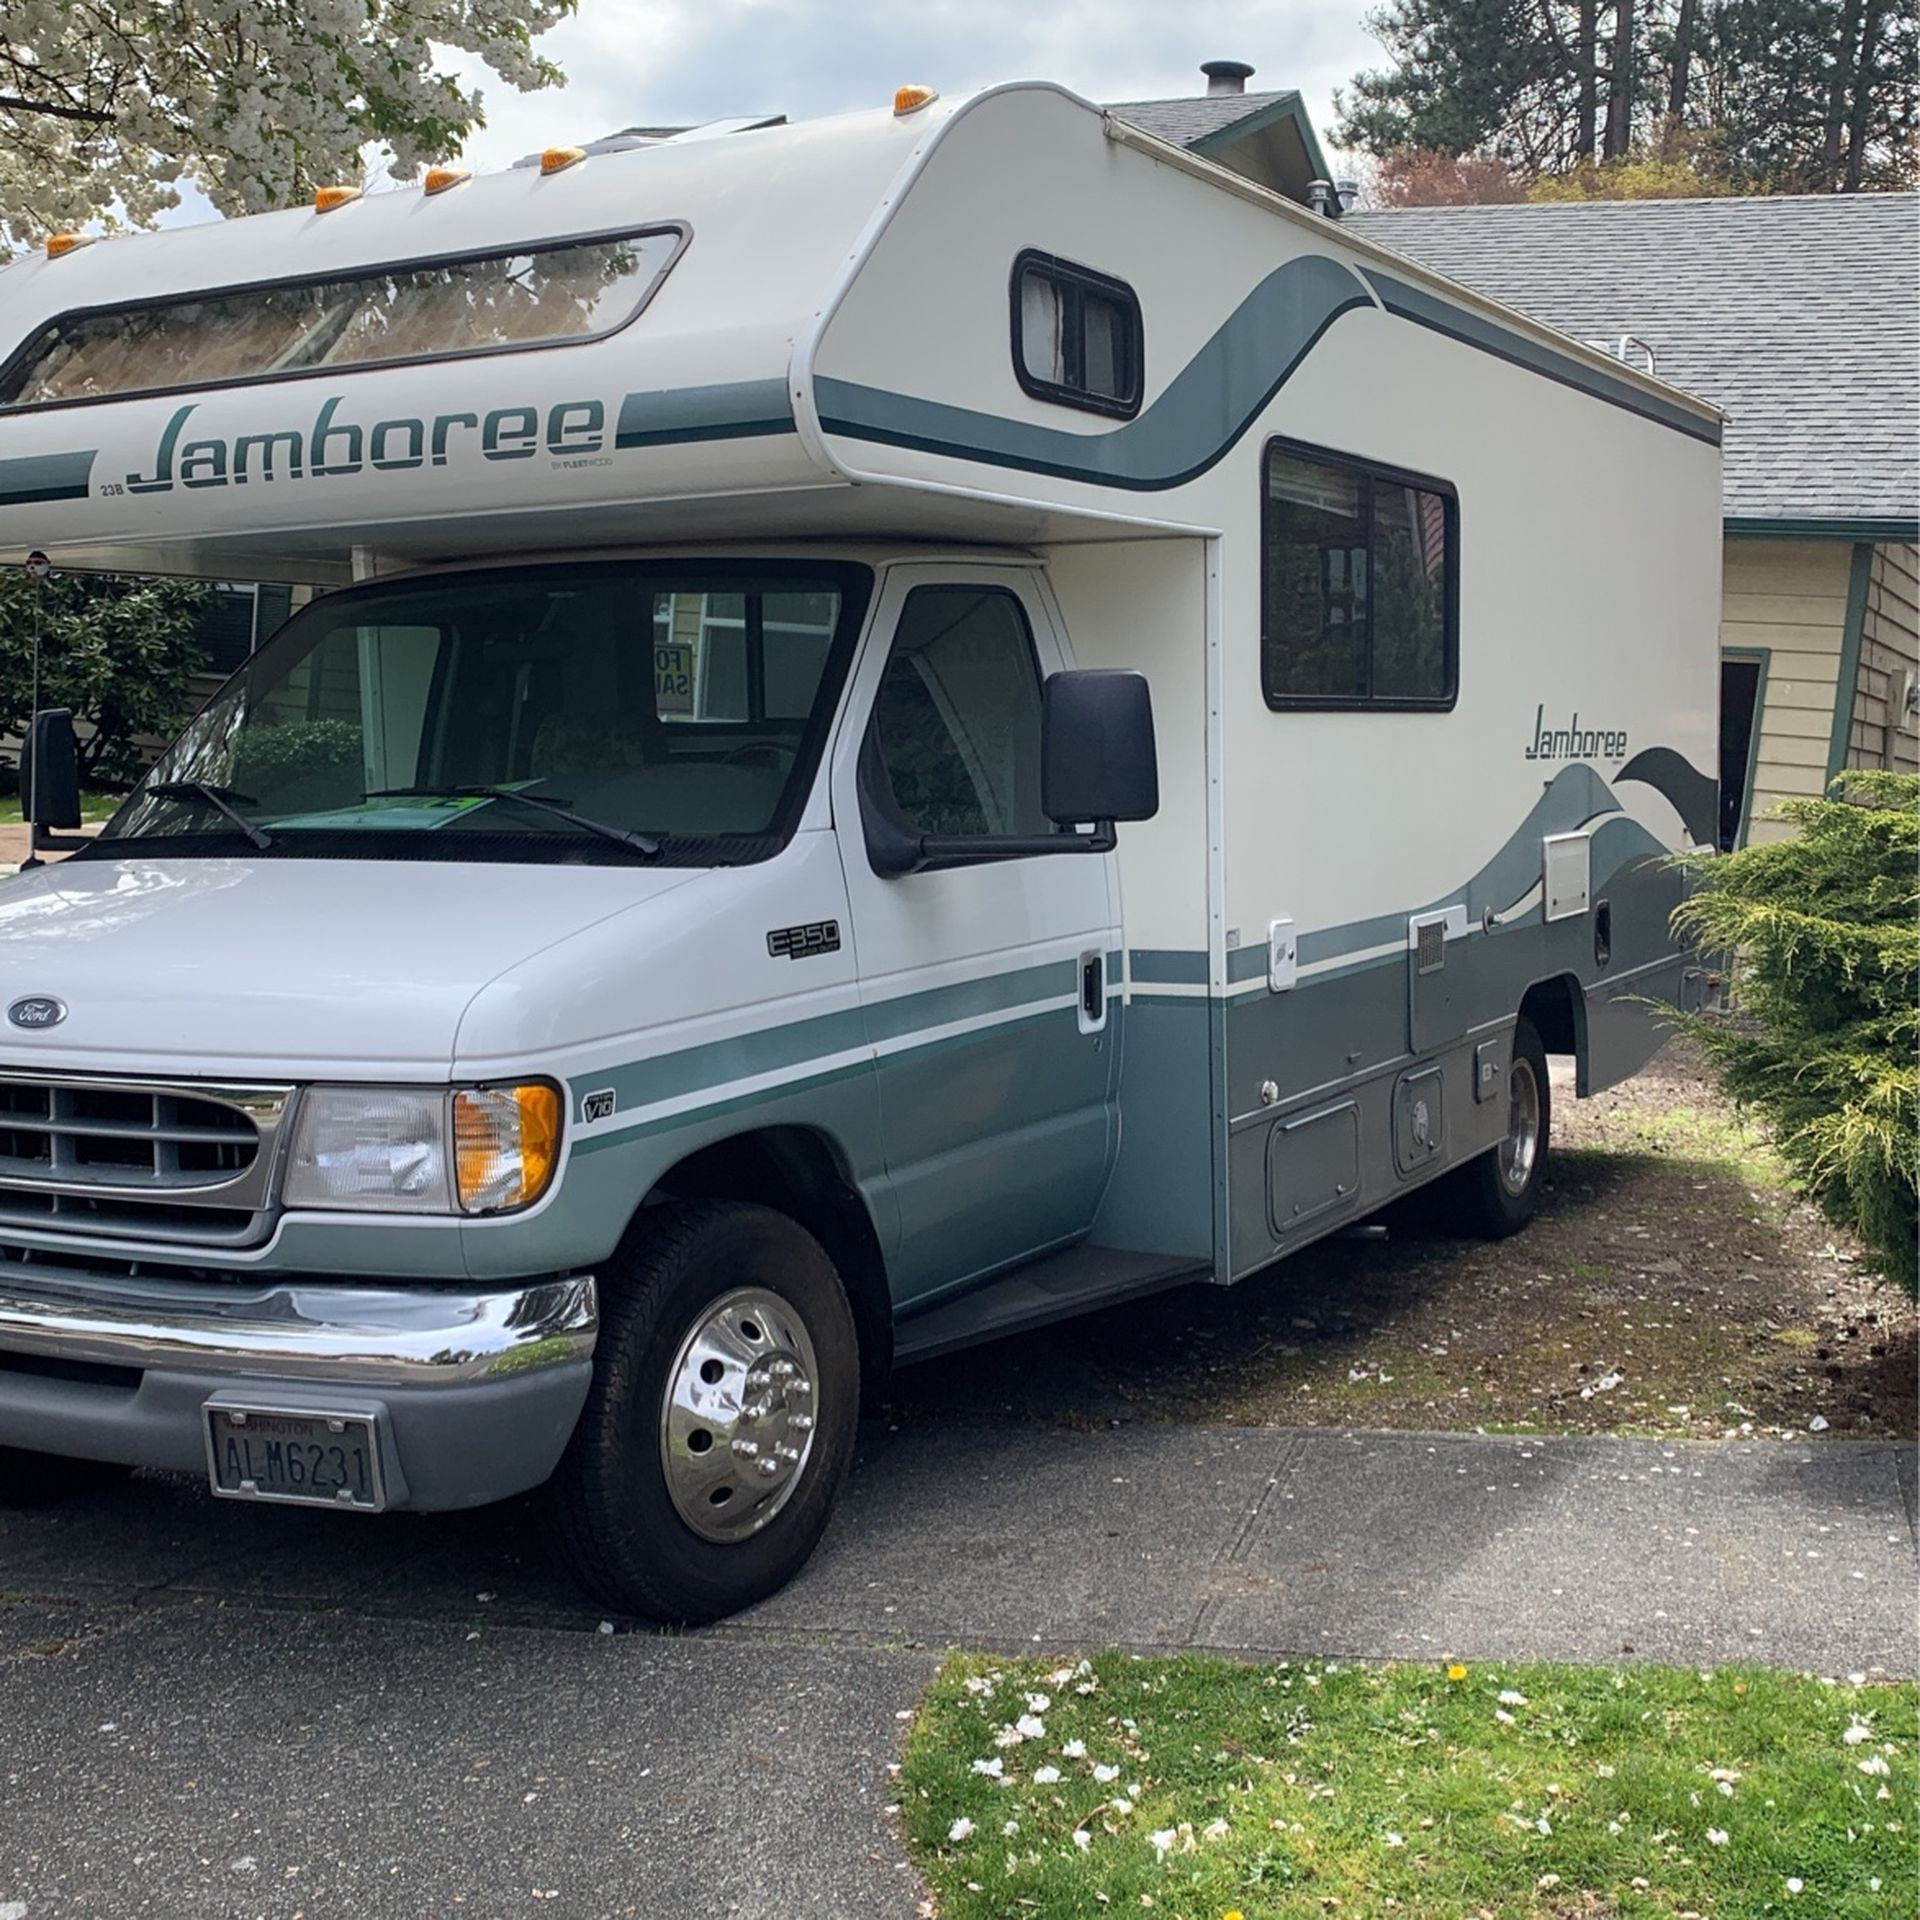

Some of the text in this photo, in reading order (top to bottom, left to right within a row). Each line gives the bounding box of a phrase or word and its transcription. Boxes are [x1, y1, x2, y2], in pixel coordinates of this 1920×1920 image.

[100, 396, 603, 496] 23B Jamboree
[1525, 704, 1627, 760] Jamboree
[19, 1003, 51, 1021] Ford
[586, 1100, 612, 1121] V10
[226, 1437, 366, 1491] ALM6231
